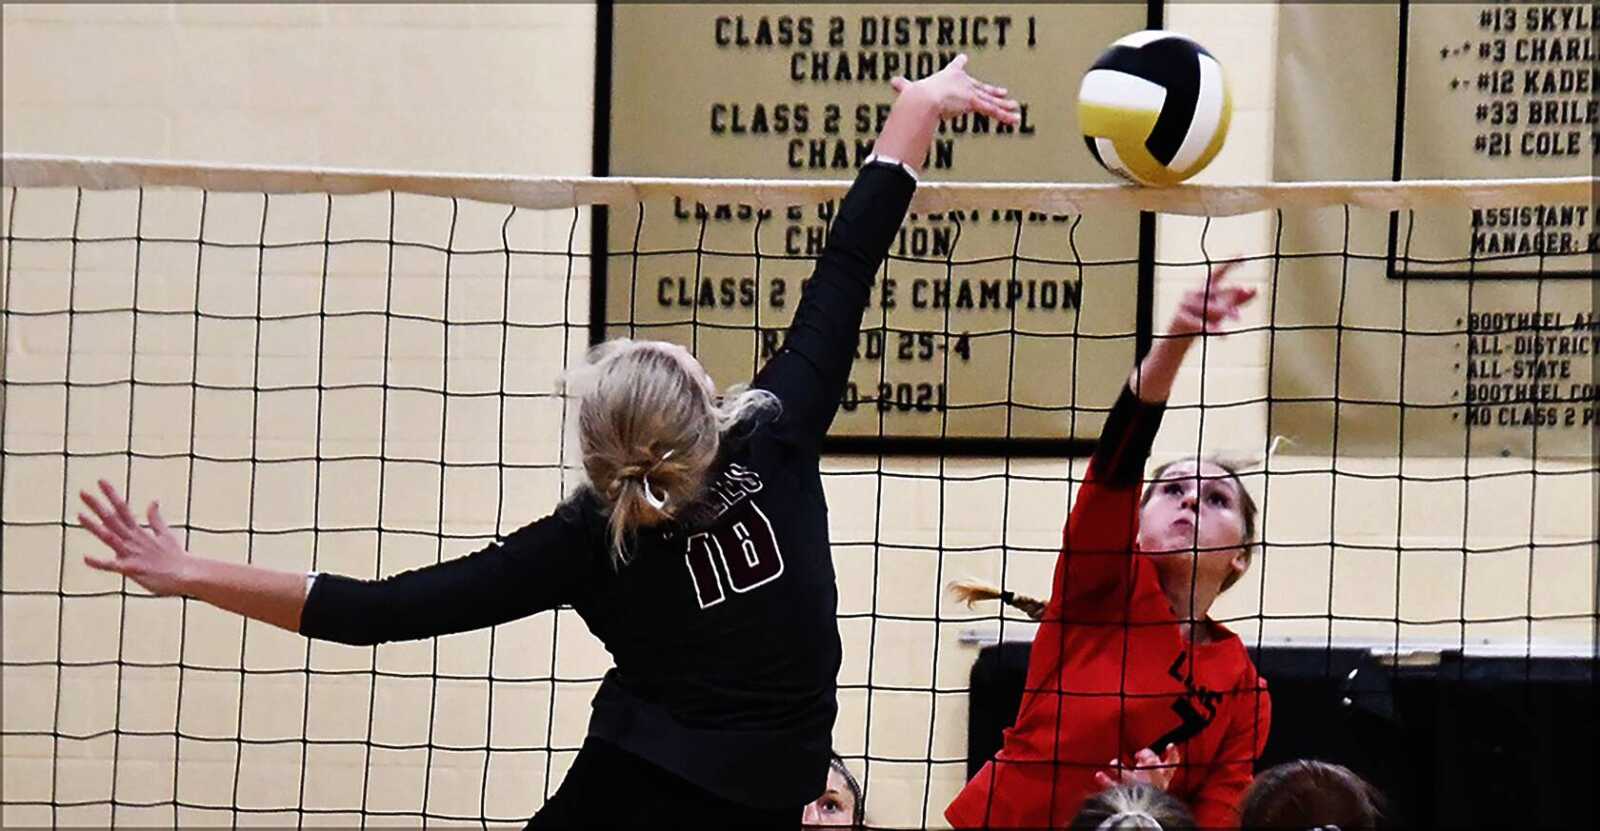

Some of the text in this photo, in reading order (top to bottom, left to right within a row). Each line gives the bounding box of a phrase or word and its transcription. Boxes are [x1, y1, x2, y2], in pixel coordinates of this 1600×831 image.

[1479, 7, 1517, 31] #13
[715, 16, 1037, 47] CLASS 2 DISTRICT 1
[1479, 38, 1507, 62] #3
[1477, 70, 1514, 94] #12
[711, 104, 809, 134] CLASS
[823, 104, 840, 134] 2
[1476, 101, 1518, 125] #33
[1474, 132, 1511, 156] #21
[1521, 131, 1581, 156] COLE
[1471, 205, 1588, 227] ASSISTANT
[657, 277, 756, 308] CLASS
[770, 277, 786, 308] 2
[912, 279, 1081, 310] CHAMPION
[898, 331, 970, 361] 25-4
[1498, 408, 1558, 426] CLASS
[1564, 408, 1576, 426] 2
